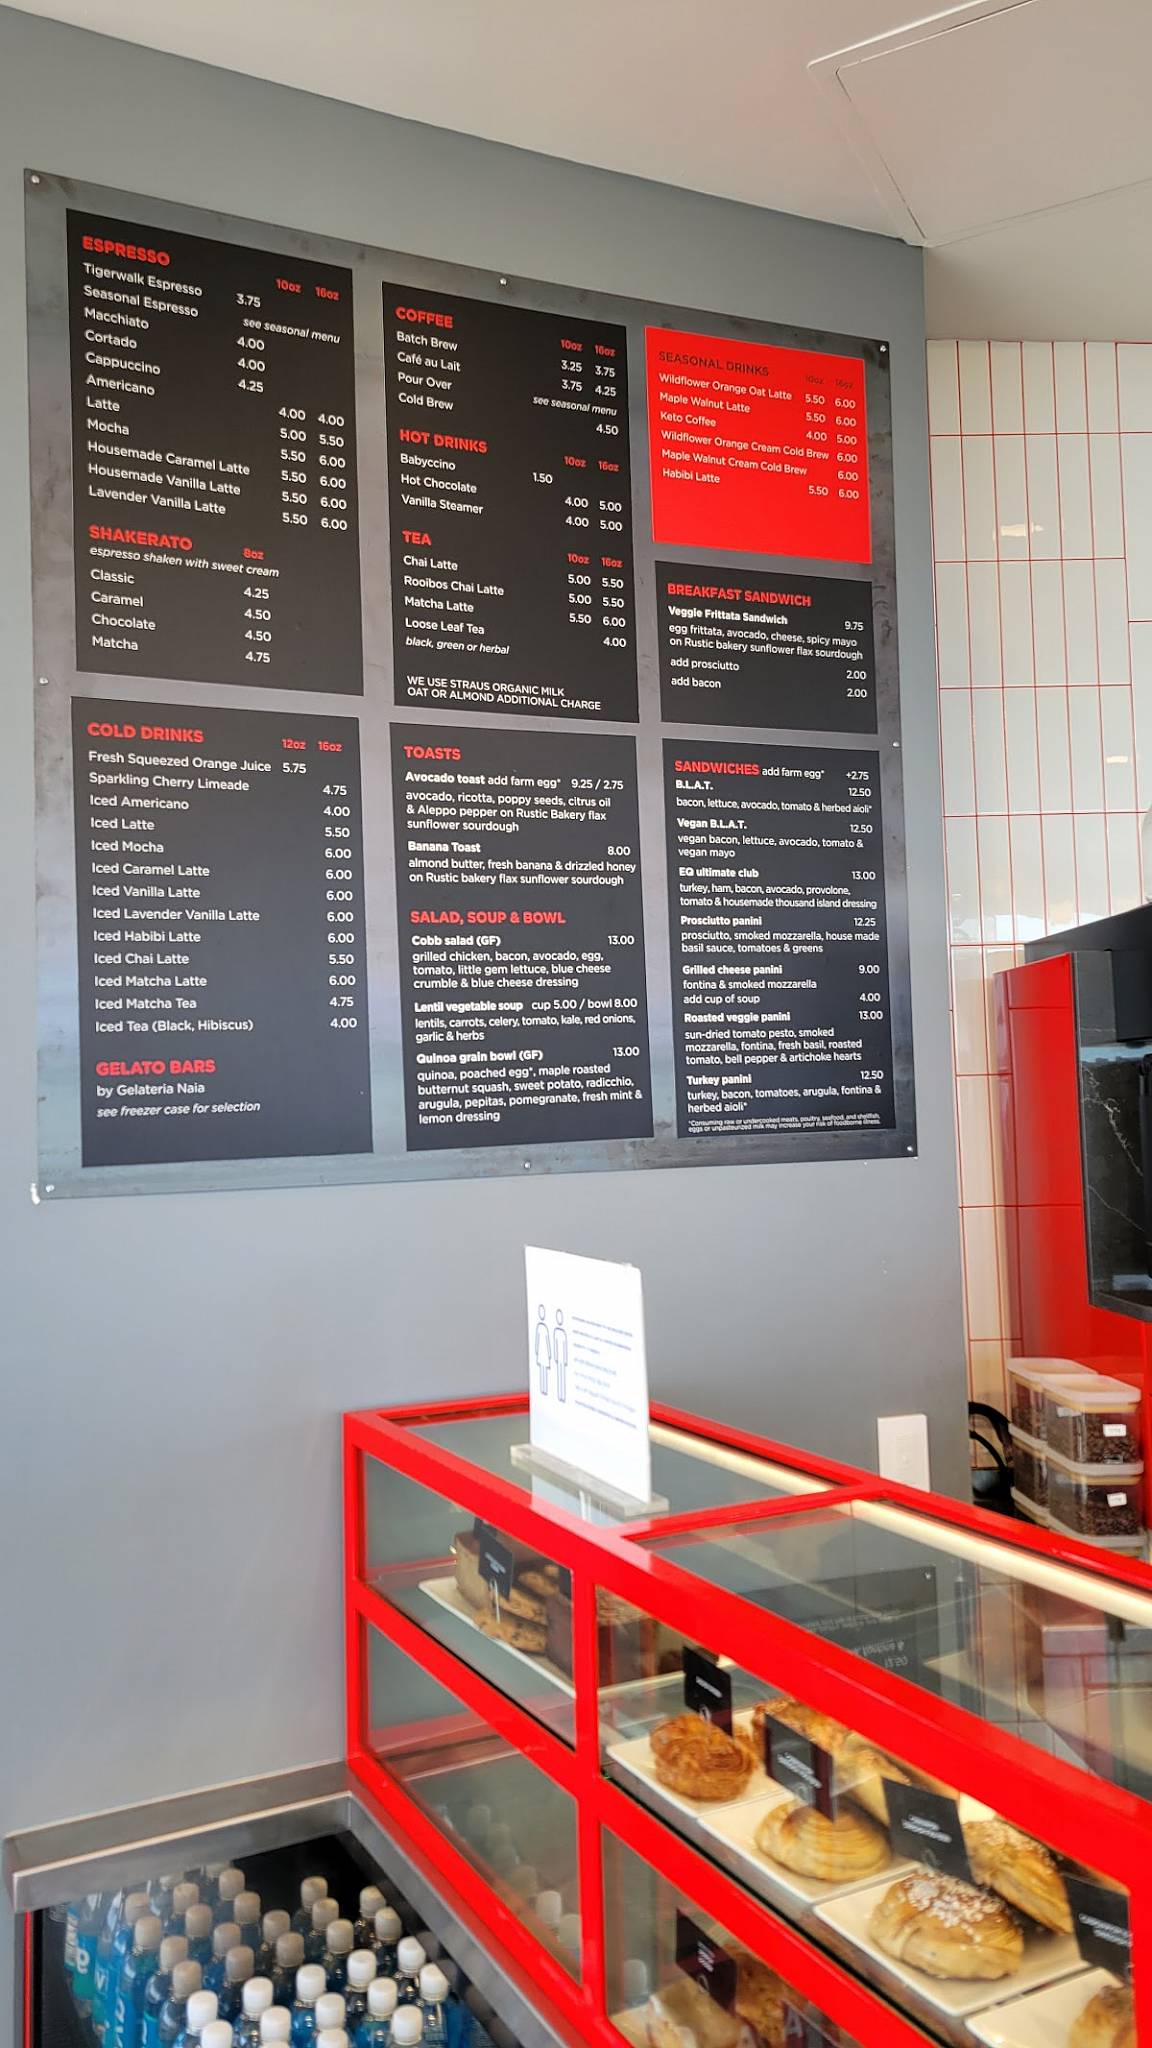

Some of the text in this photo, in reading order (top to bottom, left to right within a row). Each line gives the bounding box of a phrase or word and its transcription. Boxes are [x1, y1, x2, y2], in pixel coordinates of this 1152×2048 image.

[82, 235, 339, 300] ESPRESSO 10oz 16oz
[83, 262, 261, 307] Tigerwalk Espresso 3.75
[84, 307, 265, 351] Macchiato 4.00
[395, 306, 615, 357] COFFEE 10oz 16oz
[396, 331, 615, 377] Batch Brew 3.25 3.75
[659, 351, 723, 370] SEASONAL
[726, 361, 769, 376] DRINKS
[397, 351, 616, 397] Café au Lait 3.75 4.25
[86, 374, 344, 427] Americano 4.00 4.00
[659, 373, 856, 409] Wildflower Orange Oat Latte 5.50 6.00
[660, 411, 857, 445] Keto Coffee 4.00 5.00
[399, 428, 619, 472] HOT DRINKS 10oz 16oz
[88, 440, 346, 489] Housemade Caramel Latte 5.50 6.00
[400, 453, 553, 484] Babyccino 1.50
[662, 467, 859, 499] Habibi Latte 5.50 6.00
[89, 524, 264, 560] SHAKERATO 8oz
[89, 547, 279, 577] espresso shaken with sweet cream
[667, 582, 812, 607] BREAKFAST SANDWICH
[91, 613, 271, 642] Chocolate 4.50
[668, 605, 864, 631] Veggie Frittata Sandwich 9.75
[669, 624, 857, 647] egg frittata, avocado, cheese, spicy mayo
[670, 657, 867, 680] add prosciutto 2.00
[406, 675, 564, 696] WE USE STRAUS ORGANIC MILK
[87, 722, 342, 752] COLD DRINKS 12oz 16oz
[88, 750, 306, 773] Fresh Squeezed Orange Juice 5.75
[403, 745, 461, 760] TOASTS
[405, 771, 455, 783] Avocado
[456, 774, 485, 785] toast
[487, 775, 508, 785] add
[510, 775, 535, 786] farm
[571, 778, 593, 789] 9.25
[595, 778, 601, 790] /
[603, 779, 624, 790] 2.75
[675, 760, 760, 775] SANDWICHES
[762, 766, 780, 776] add
[781, 767, 802, 777] farm
[846, 771, 869, 780] +2.75
[89, 772, 347, 795] Sparkling Cherry Limeade 4.75
[675, 779, 871, 797] B.L.A.T. 12.50
[405, 791, 611, 807] avocado, ricotta, poppy seeds, citrus oil
[678, 867, 876, 880] EQ ultimate club 13.00
[680, 896, 877, 909] tomato & housemade thousand island dressing
[410, 911, 566, 925] SALAD, SOUP & BOWL
[411, 935, 635, 947] Cobb salad (GF) 13.00
[682, 964, 880, 976] Grilled cheese panini 9.00
[95, 1017, 357, 1032] Iced Tea (Black, Hibiscus) 4.00
[96, 1082, 205, 1098] by Gelateria Naia
